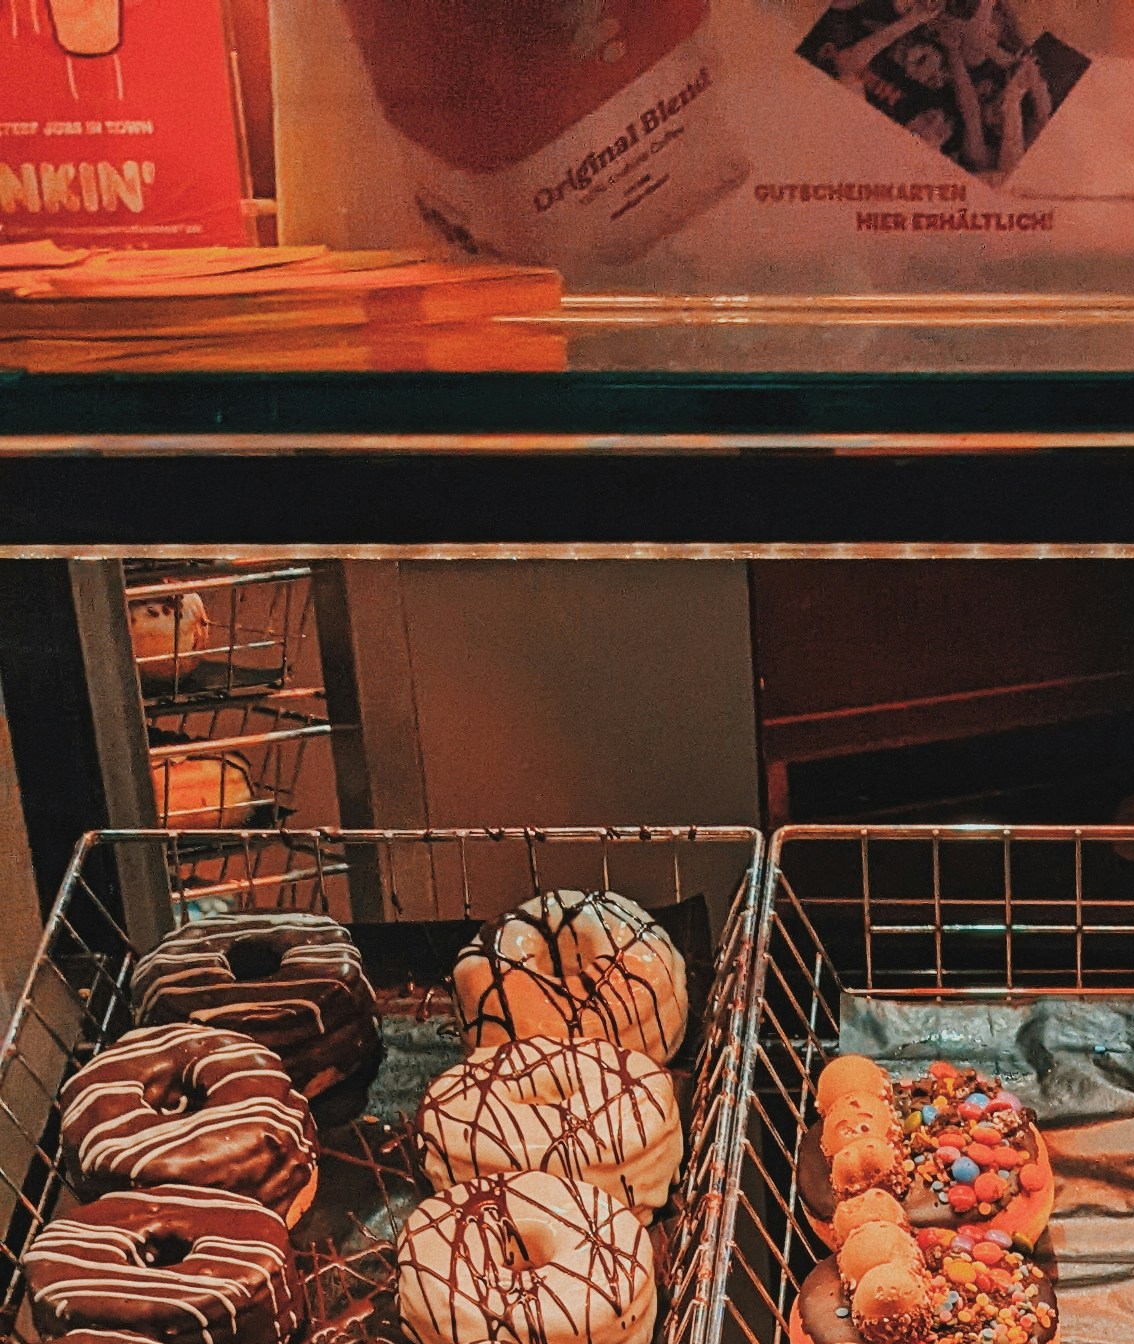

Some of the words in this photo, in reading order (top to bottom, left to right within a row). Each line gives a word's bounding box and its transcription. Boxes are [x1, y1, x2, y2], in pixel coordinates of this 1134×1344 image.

[533, 122, 641, 213] Original
[639, 65, 712, 136] Blend
[753, 183, 967, 202] GUTSCHEINKARTEN
[856, 211, 905, 232] HIER
[912, 207, 1054, 232] ERHÄLTLICH!
